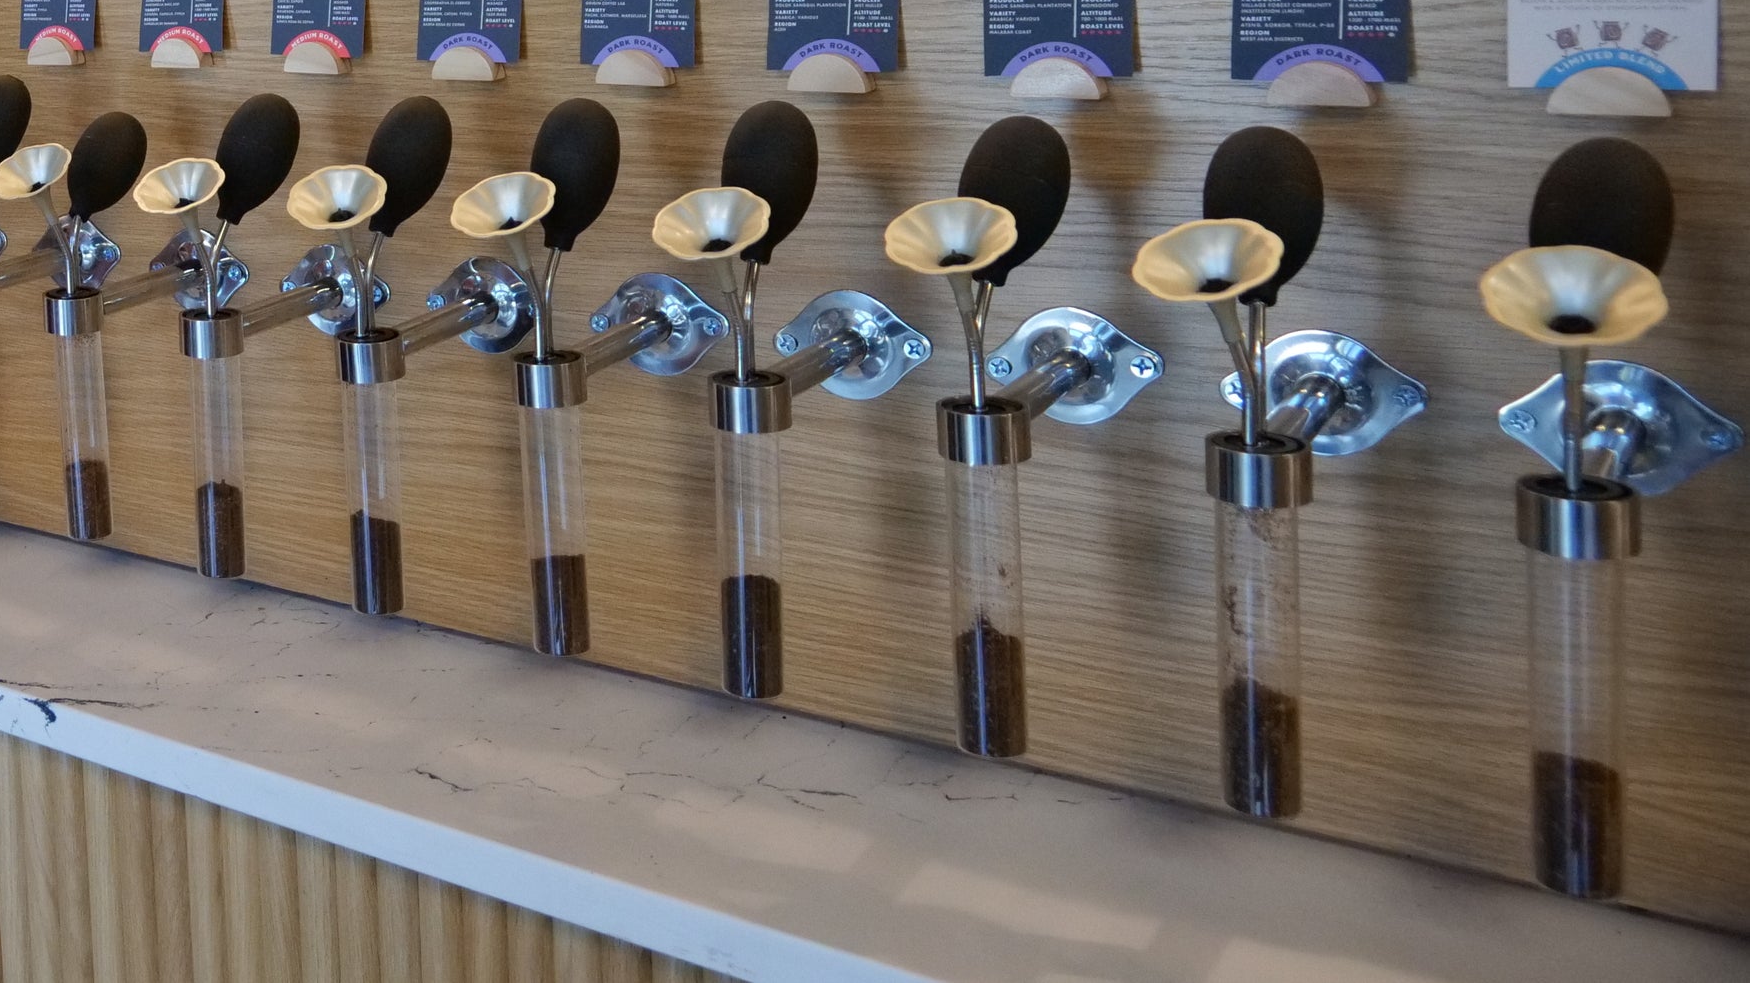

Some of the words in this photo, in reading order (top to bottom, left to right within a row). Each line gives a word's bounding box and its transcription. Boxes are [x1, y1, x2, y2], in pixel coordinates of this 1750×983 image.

[182, 29, 203, 44] ROAST
[291, 32, 317, 48] MEDIUM
[319, 32, 343, 49] ROAST
[443, 37, 464, 49] DARK
[467, 36, 492, 49] ROAST
[608, 40, 631, 53] DARK
[634, 39, 663, 53] ROAST
[799, 43, 826, 57] DARK
[830, 43, 863, 57] ROAST
[1020, 47, 1049, 62] DARK
[1054, 45, 1093, 62] ROAST
[1276, 49, 1311, 66] DARK
[1316, 48, 1362, 66] ROAST
[1555, 51, 1613, 73] LIMITED
[1618, 52, 1665, 74] BLEND
